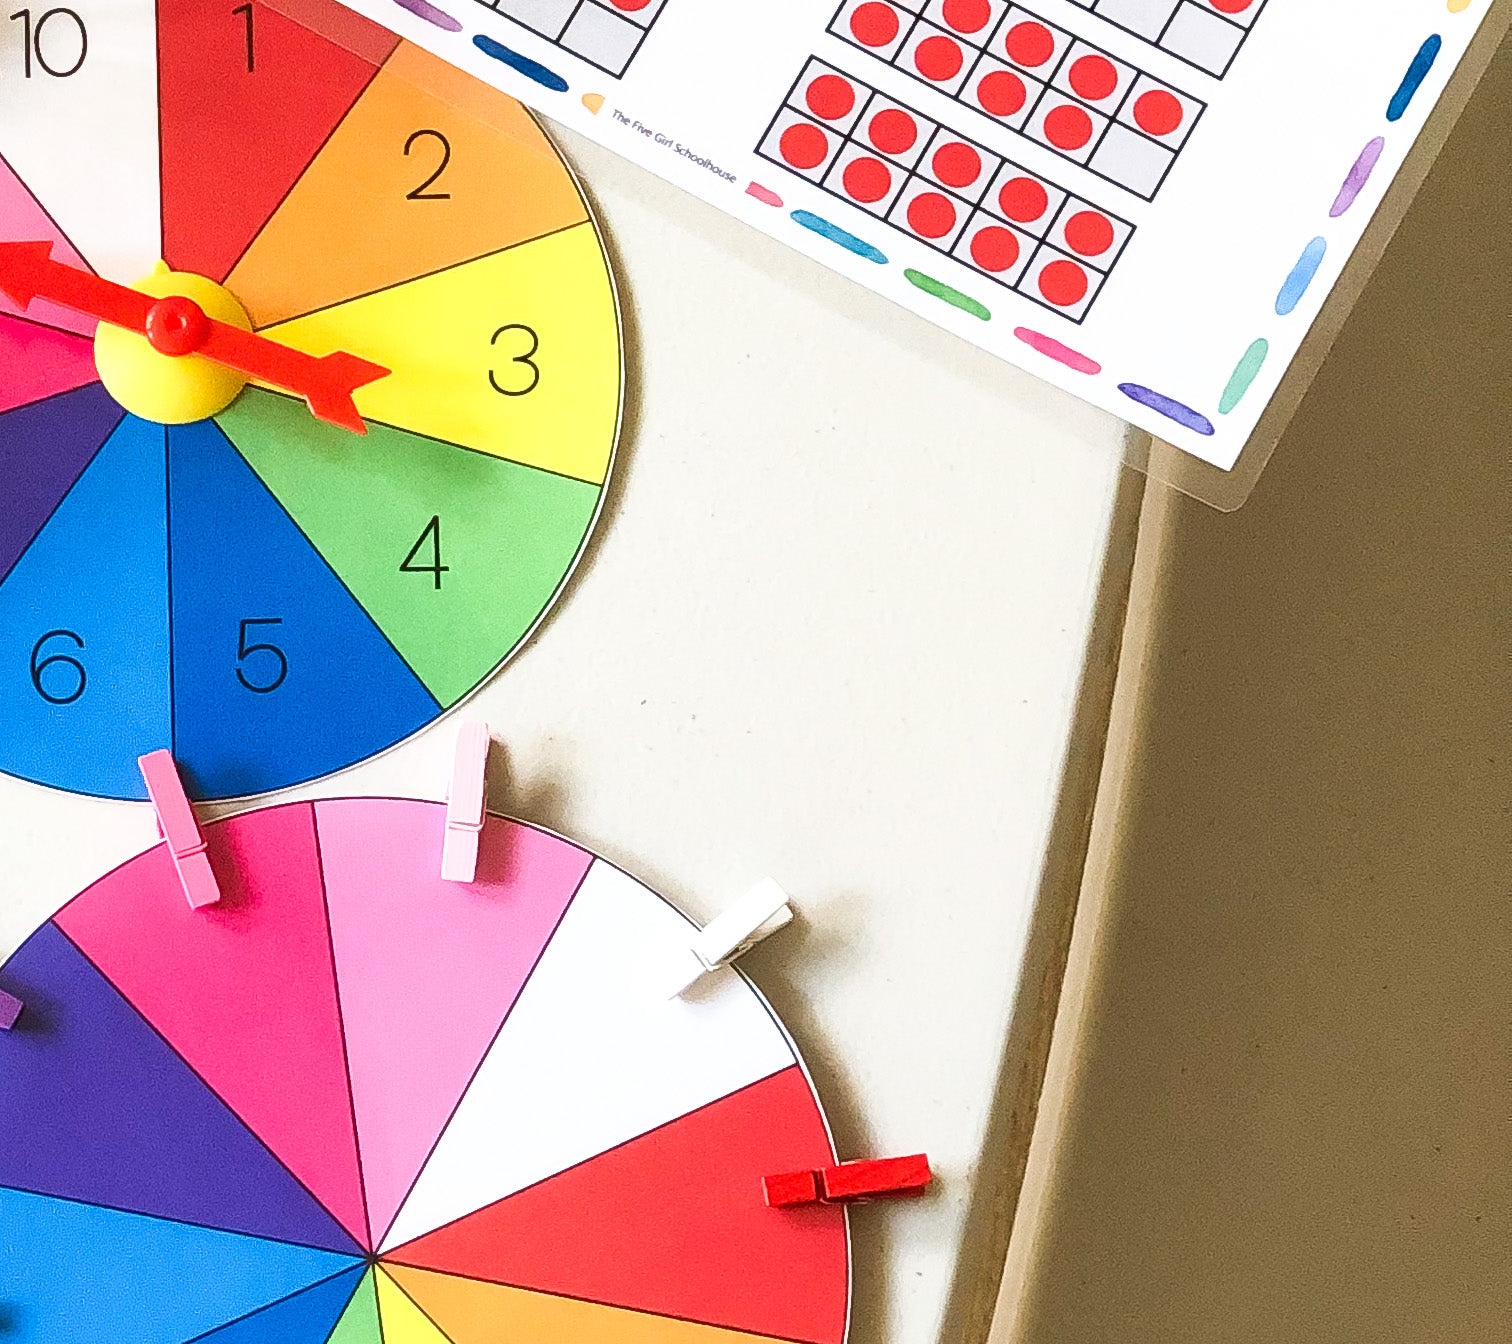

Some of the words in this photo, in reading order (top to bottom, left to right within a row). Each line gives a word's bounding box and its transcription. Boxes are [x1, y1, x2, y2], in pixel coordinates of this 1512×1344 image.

[9, 7, 88, 79] 10
[231, 2, 255, 73] 1
[403, 129, 452, 201] 2
[612, 110, 631, 125] The
[632, 121, 653, 137] Five
[654, 133, 674, 148] Girl
[675, 143, 736, 183] Schoolhouse
[488, 323, 540, 397] 3
[399, 515, 450, 590] 4
[29, 629, 87, 705] 6
[233, 617, 288, 694] 5
